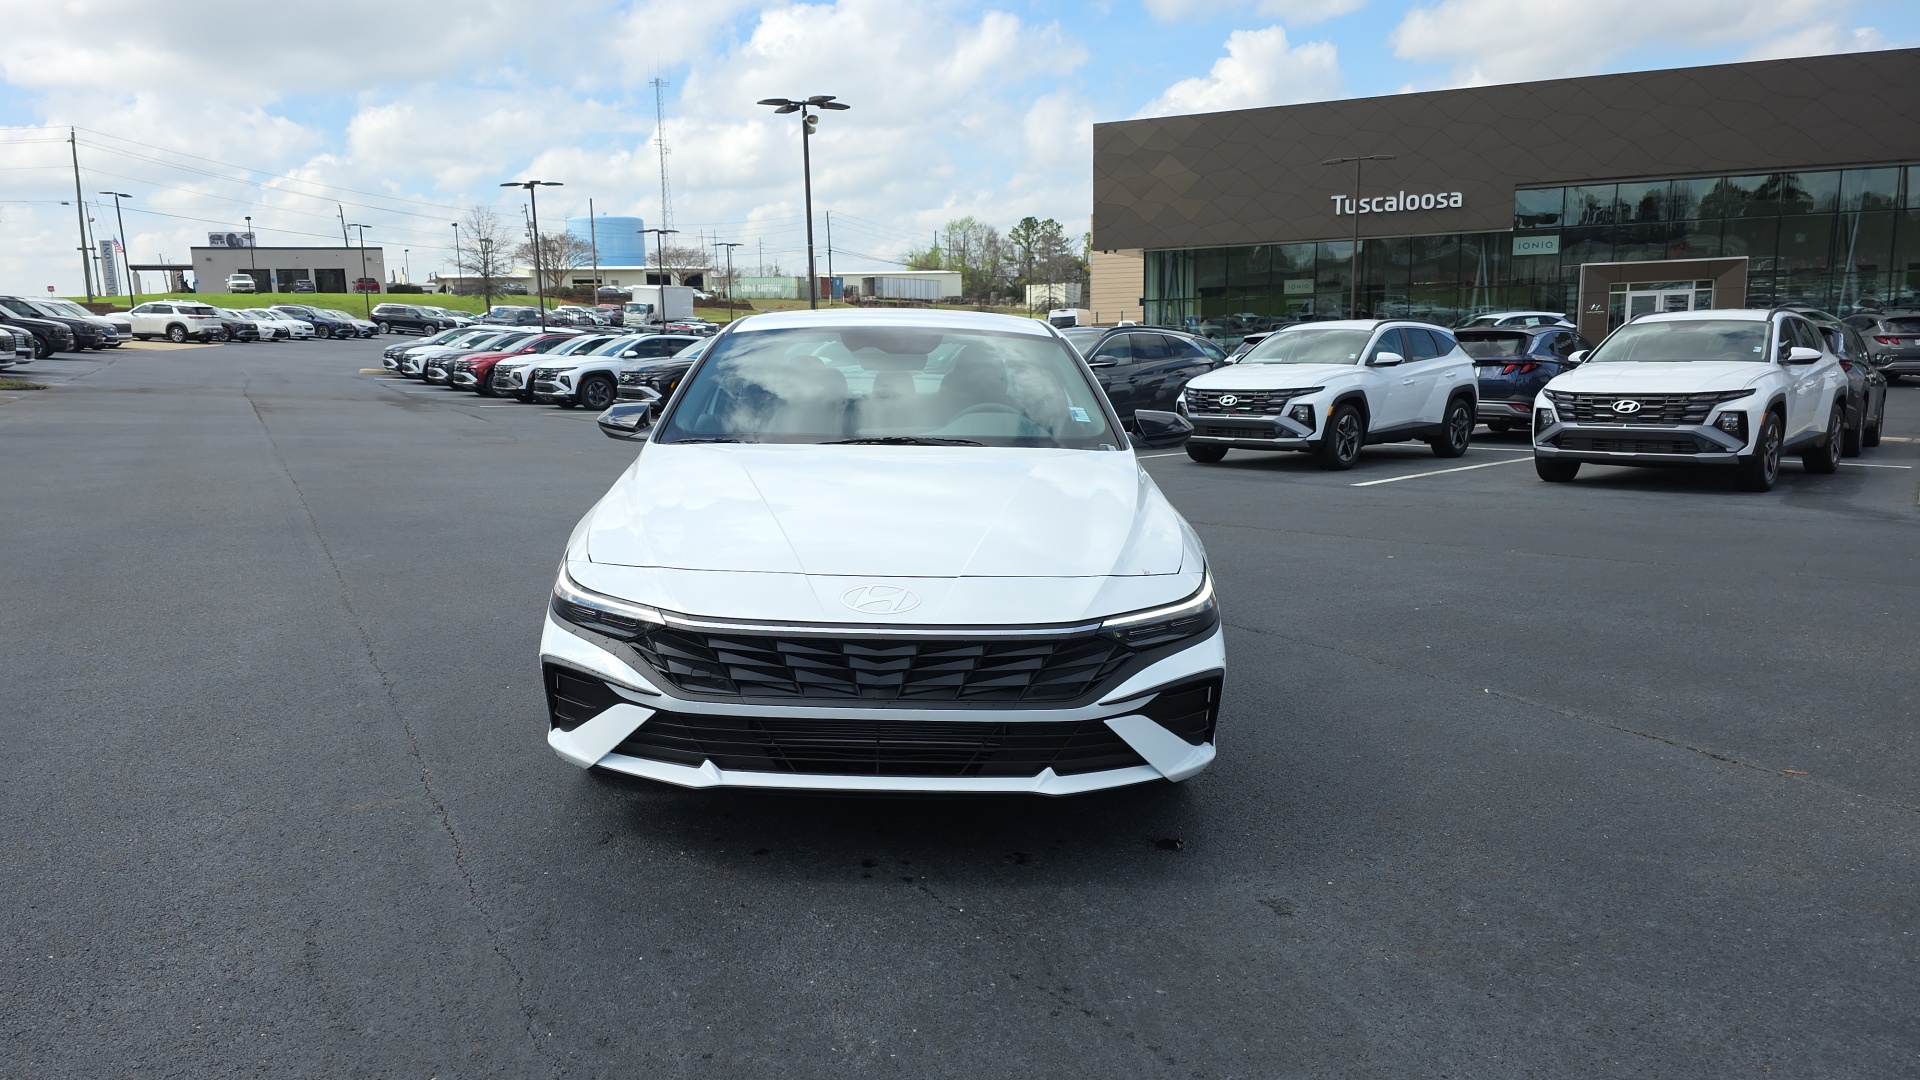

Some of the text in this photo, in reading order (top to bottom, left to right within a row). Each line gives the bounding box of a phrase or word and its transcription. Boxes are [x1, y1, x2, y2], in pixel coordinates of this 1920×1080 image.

[1330, 190, 1463, 216] Tuscaloosa
[1518, 241, 1554, 250] IONIQ
[102, 240, 117, 293] Alabama ONE
